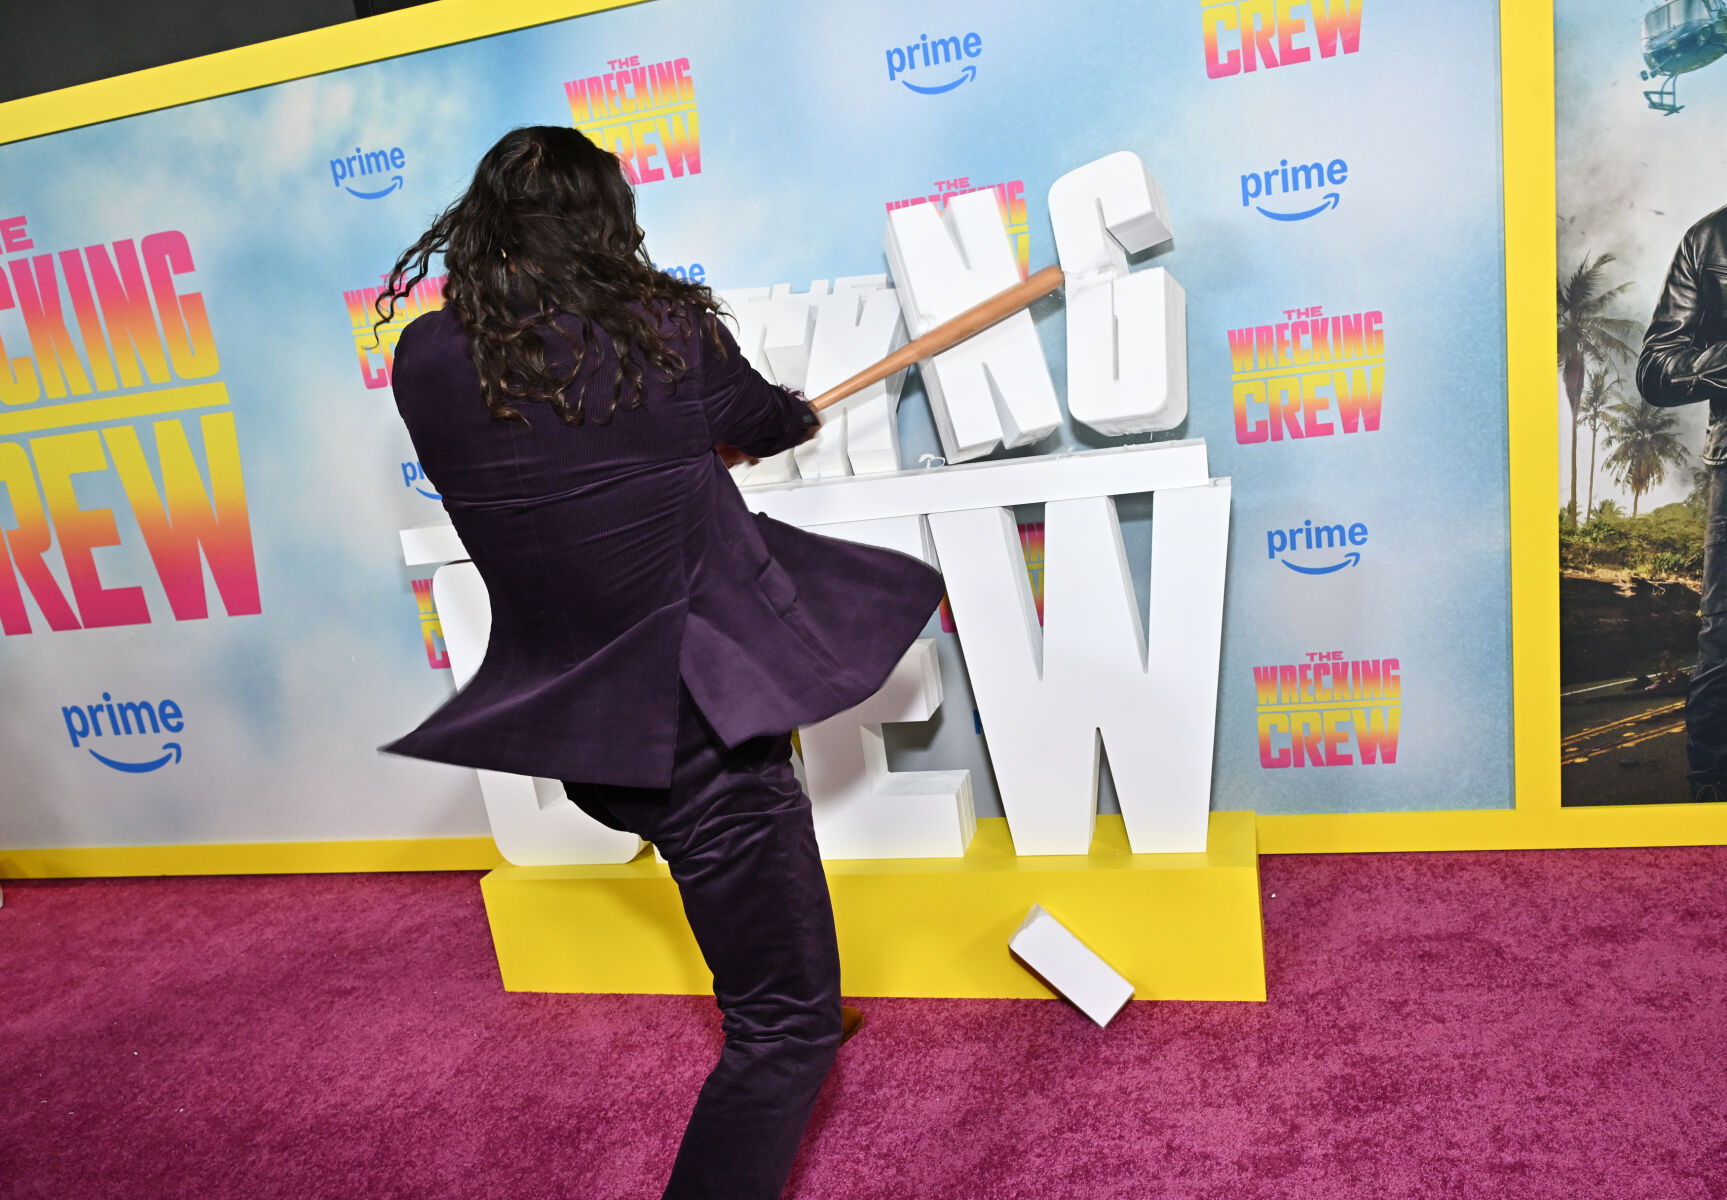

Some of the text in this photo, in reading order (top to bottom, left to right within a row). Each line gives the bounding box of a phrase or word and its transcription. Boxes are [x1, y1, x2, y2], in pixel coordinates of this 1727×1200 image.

[607, 55, 640, 71] THE
[886, 32, 982, 80] prime
[1202, 0, 1363, 79] CREW
[564, 57, 695, 123] WRECKING
[330, 147, 405, 186] prime
[582, 110, 701, 186] REW
[934, 176, 970, 192] THE
[1240, 158, 1348, 207] prime
[1283, 305, 1323, 320] THE
[1227, 310, 1384, 372] WRECKING
[1232, 366, 1385, 445] CREW
[1267, 520, 1368, 559] prime
[1306, 650, 1343, 662] THE
[1253, 658, 1400, 704] WRECKING
[62, 692, 184, 747] prime
[1256, 707, 1401, 769] CREW
